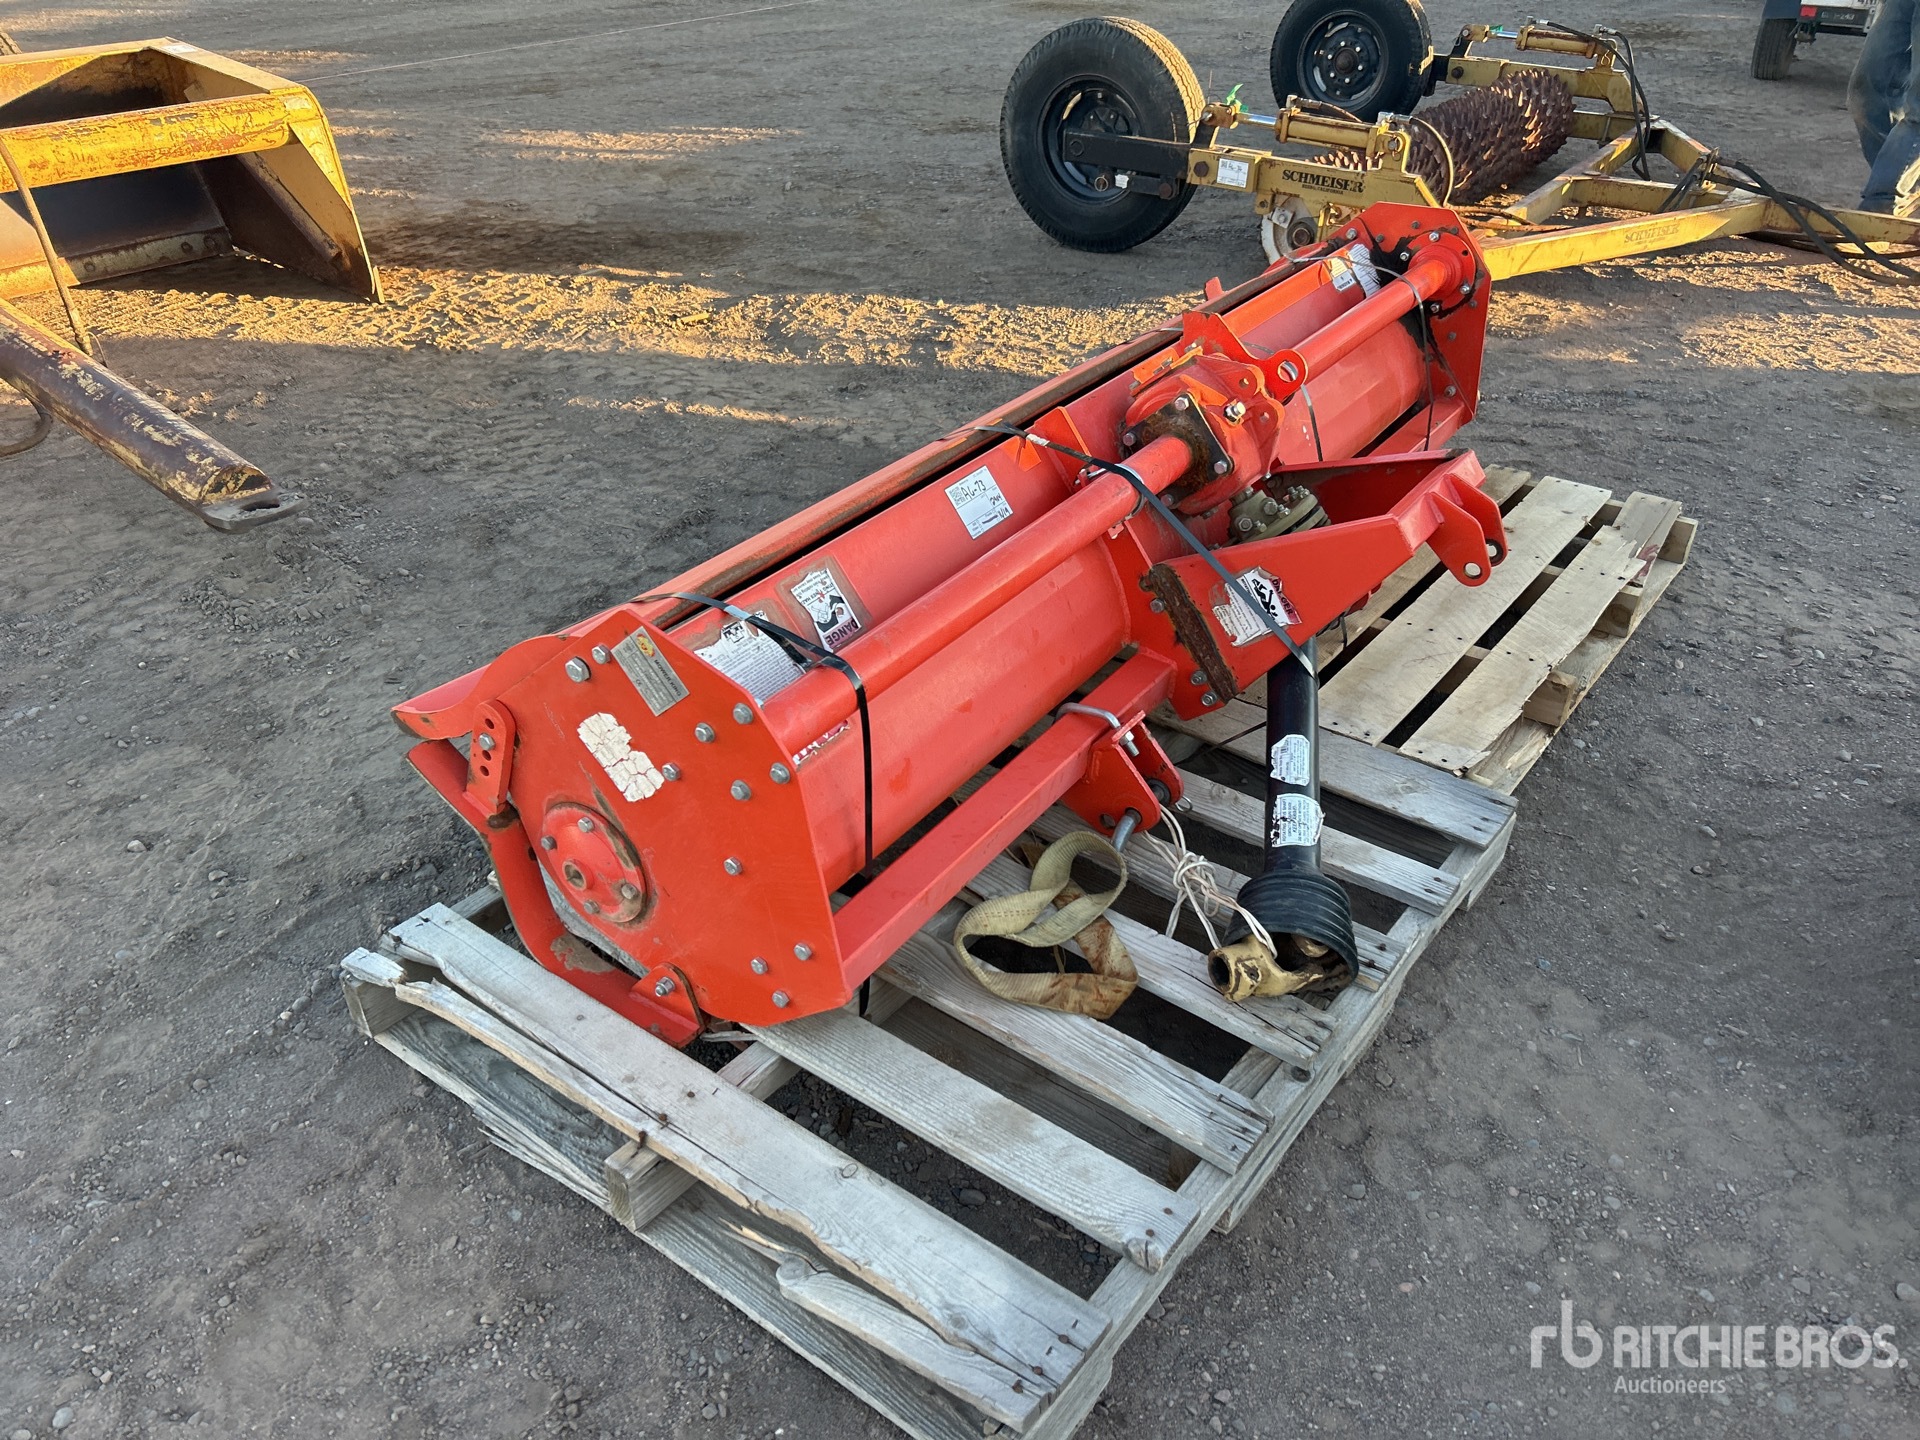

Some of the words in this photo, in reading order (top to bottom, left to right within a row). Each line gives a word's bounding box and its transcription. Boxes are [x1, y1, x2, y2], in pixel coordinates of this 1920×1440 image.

[1282, 169, 1365, 193] SCHMEISER
[1271, 578, 1294, 616] DAGER
[654, 659, 671, 682] MOWER
[669, 681, 682, 697] KING
